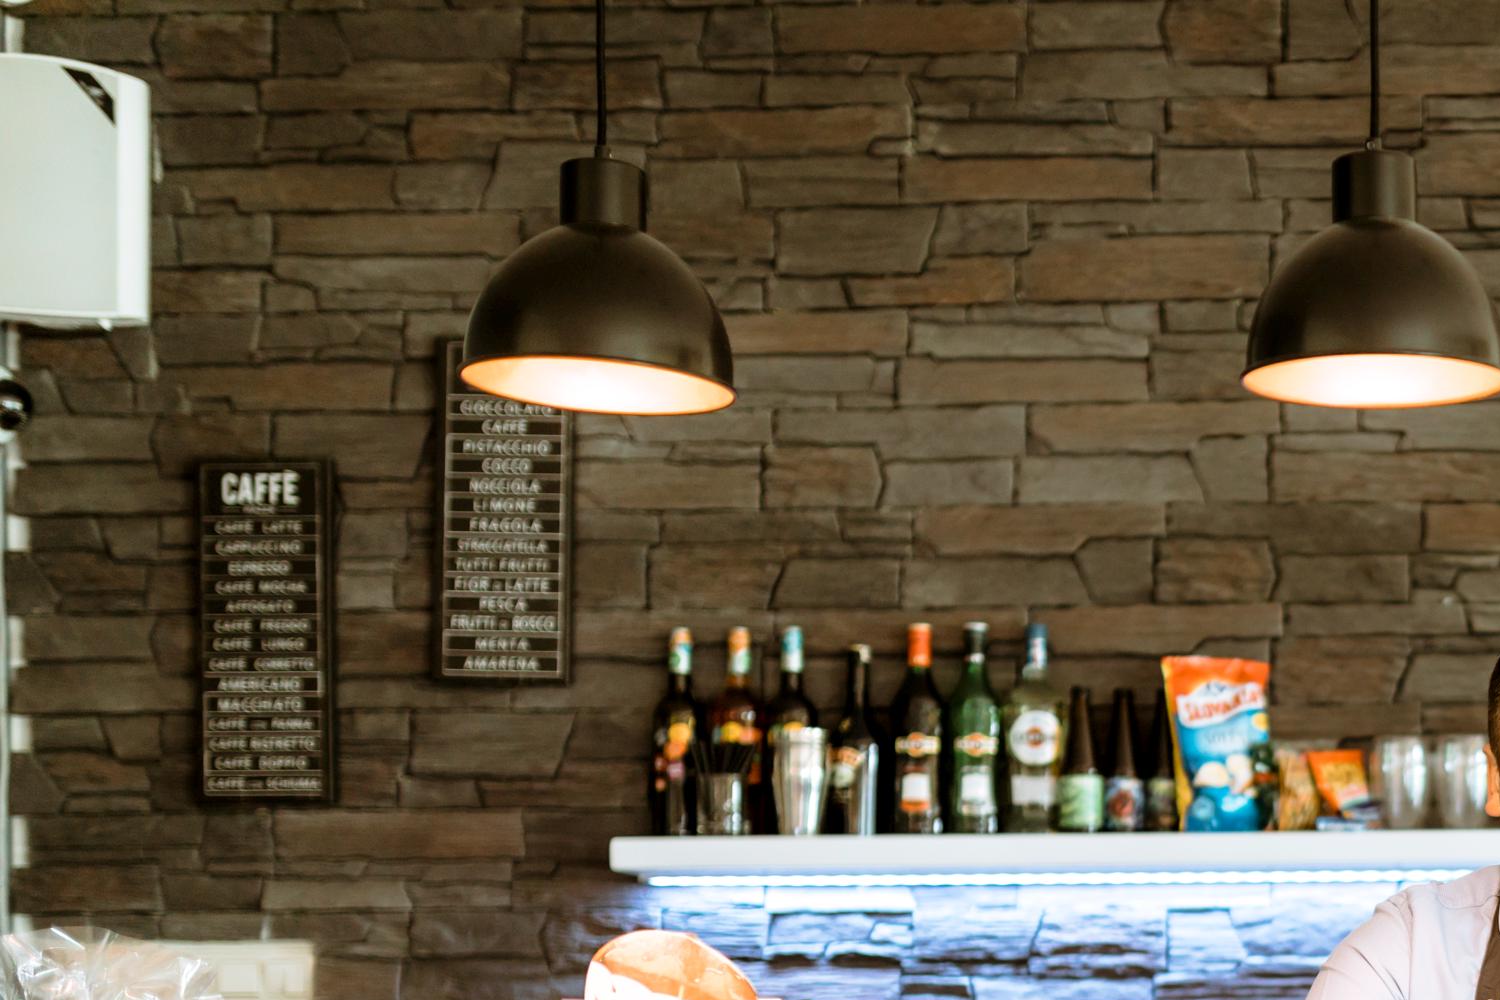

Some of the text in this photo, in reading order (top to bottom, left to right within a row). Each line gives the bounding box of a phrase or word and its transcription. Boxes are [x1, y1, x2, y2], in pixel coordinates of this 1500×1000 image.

[463, 439, 550, 456] PISTACCHIO
[482, 458, 532, 475] COCCO
[469, 478, 541, 494] NOCCIOLA
[473, 498, 536, 513] LIMONE
[261, 520, 303, 534] LATTE
[470, 517, 542, 533] FRAGOLA
[215, 540, 303, 556] CAPPUCCINO
[457, 538, 548, 553] STRACCIATELLA
[228, 560, 293, 576] ESPRESSO
[456, 557, 550, 572] TUTTI FRUTTI
[455, 576, 491, 592] FIOR
[505, 577, 550, 593] LATTE
[225, 600, 296, 613] AFFOGATO
[479, 597, 529, 613] PESCA
[260, 618, 312, 633] FREDDO
[450, 615, 498, 631] FRUTTI
[512, 616, 557, 632] BOSCO
[261, 637, 307, 651] LUNGO
[475, 638, 531, 651] MENTA
[464, 656, 541, 671] AMARENA
[217, 676, 303, 691] AMERICANO
[217, 697, 304, 712] MACCHIATO
[271, 717, 315, 730] PANNA
[250, 736, 316, 751] RISTRETTO
[258, 755, 310, 770] DOPPIO
